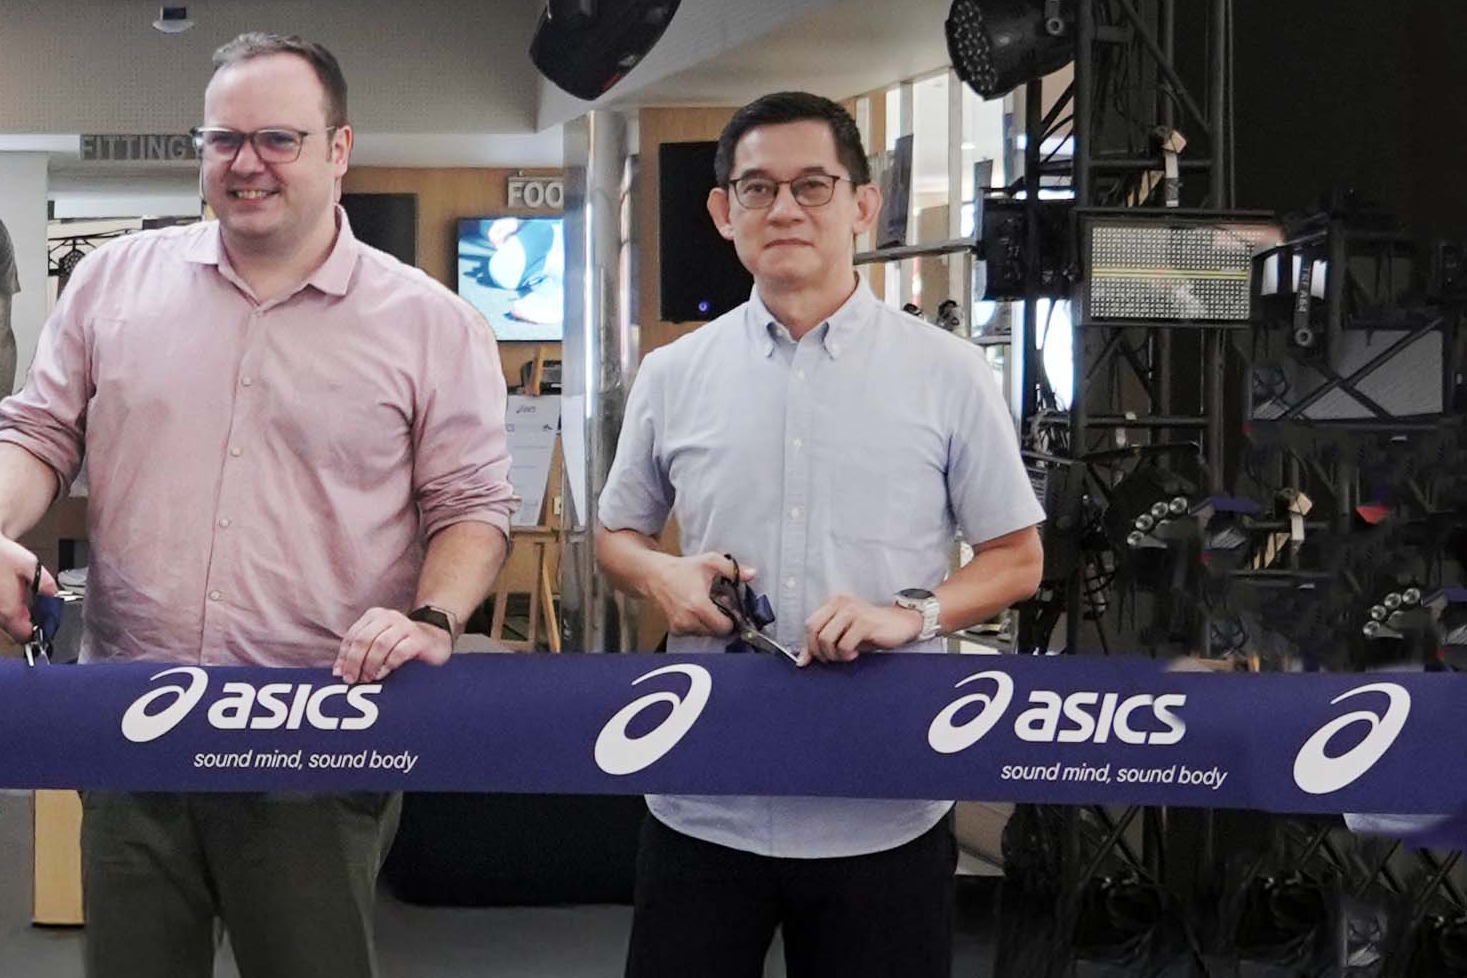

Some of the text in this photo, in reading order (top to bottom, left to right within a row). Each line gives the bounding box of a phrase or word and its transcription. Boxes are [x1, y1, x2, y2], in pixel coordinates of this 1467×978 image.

[82, 135, 188, 159] FITTING
[194, 750, 418, 773] sound mind, sound body
[1000, 762, 1228, 790] sound mind, sound body
